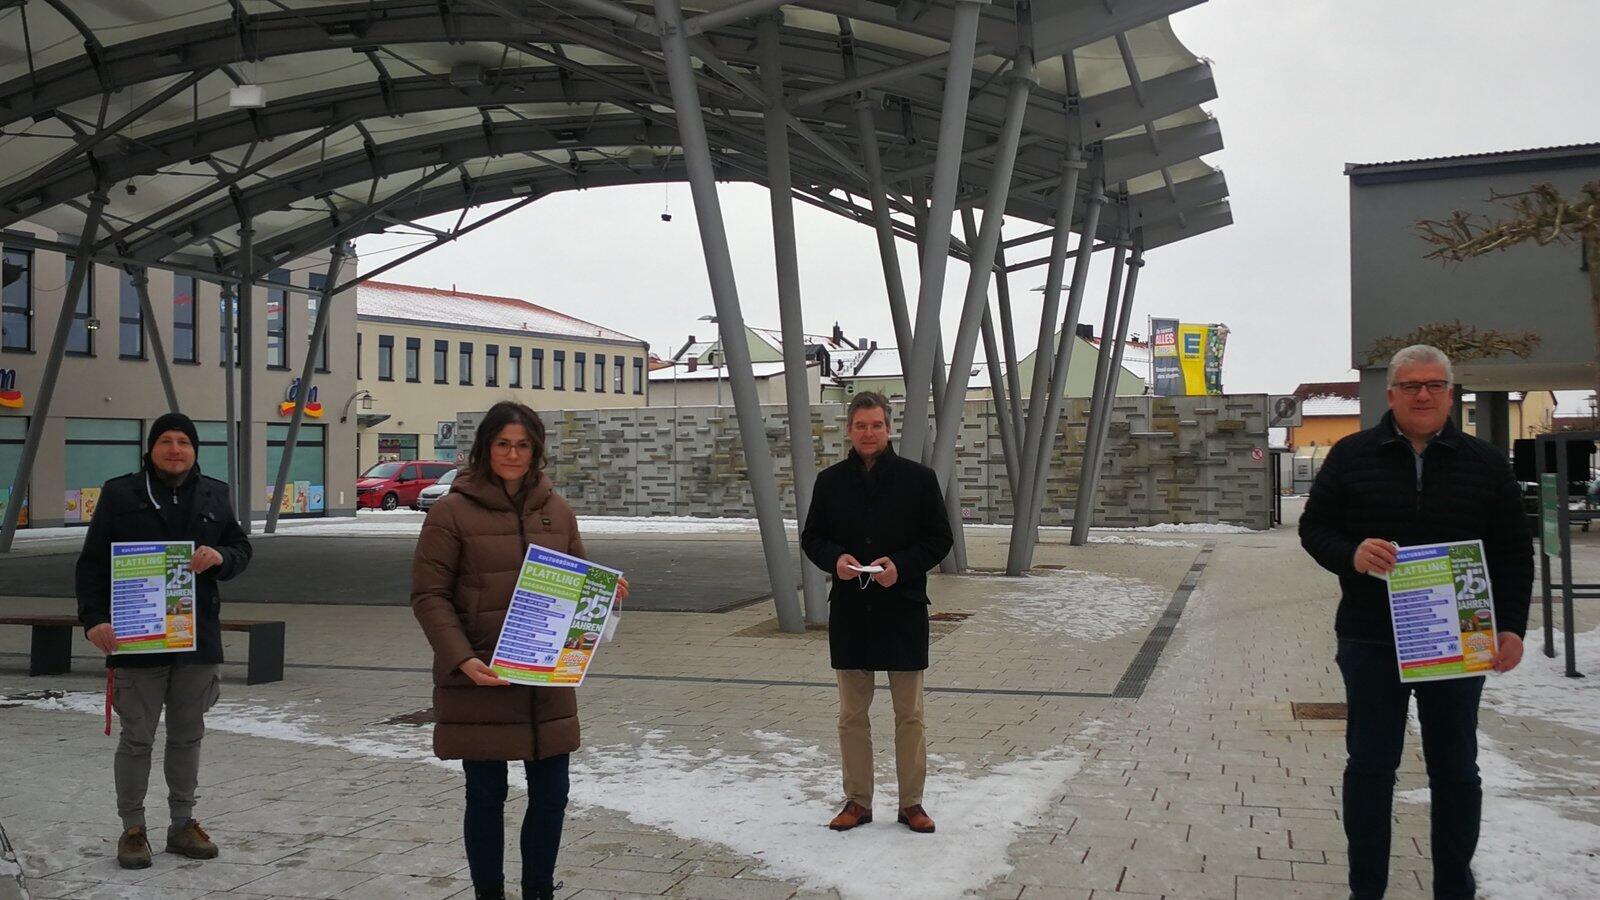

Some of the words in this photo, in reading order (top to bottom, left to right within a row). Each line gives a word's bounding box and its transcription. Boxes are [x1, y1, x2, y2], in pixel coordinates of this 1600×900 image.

[1155, 333, 1175, 345] ALLES
[0, 368, 16, 389] m
[115, 557, 162, 568] PLATTLING
[1391, 561, 1448, 577] PLATTLING
[166, 563, 192, 589] 25
[526, 565, 581, 587] PLATTLING
[1455, 569, 1487, 600] 25
[575, 594, 610, 622] 25
[1458, 598, 1490, 610] JAHREN
[571, 620, 603, 632] JAHREN
